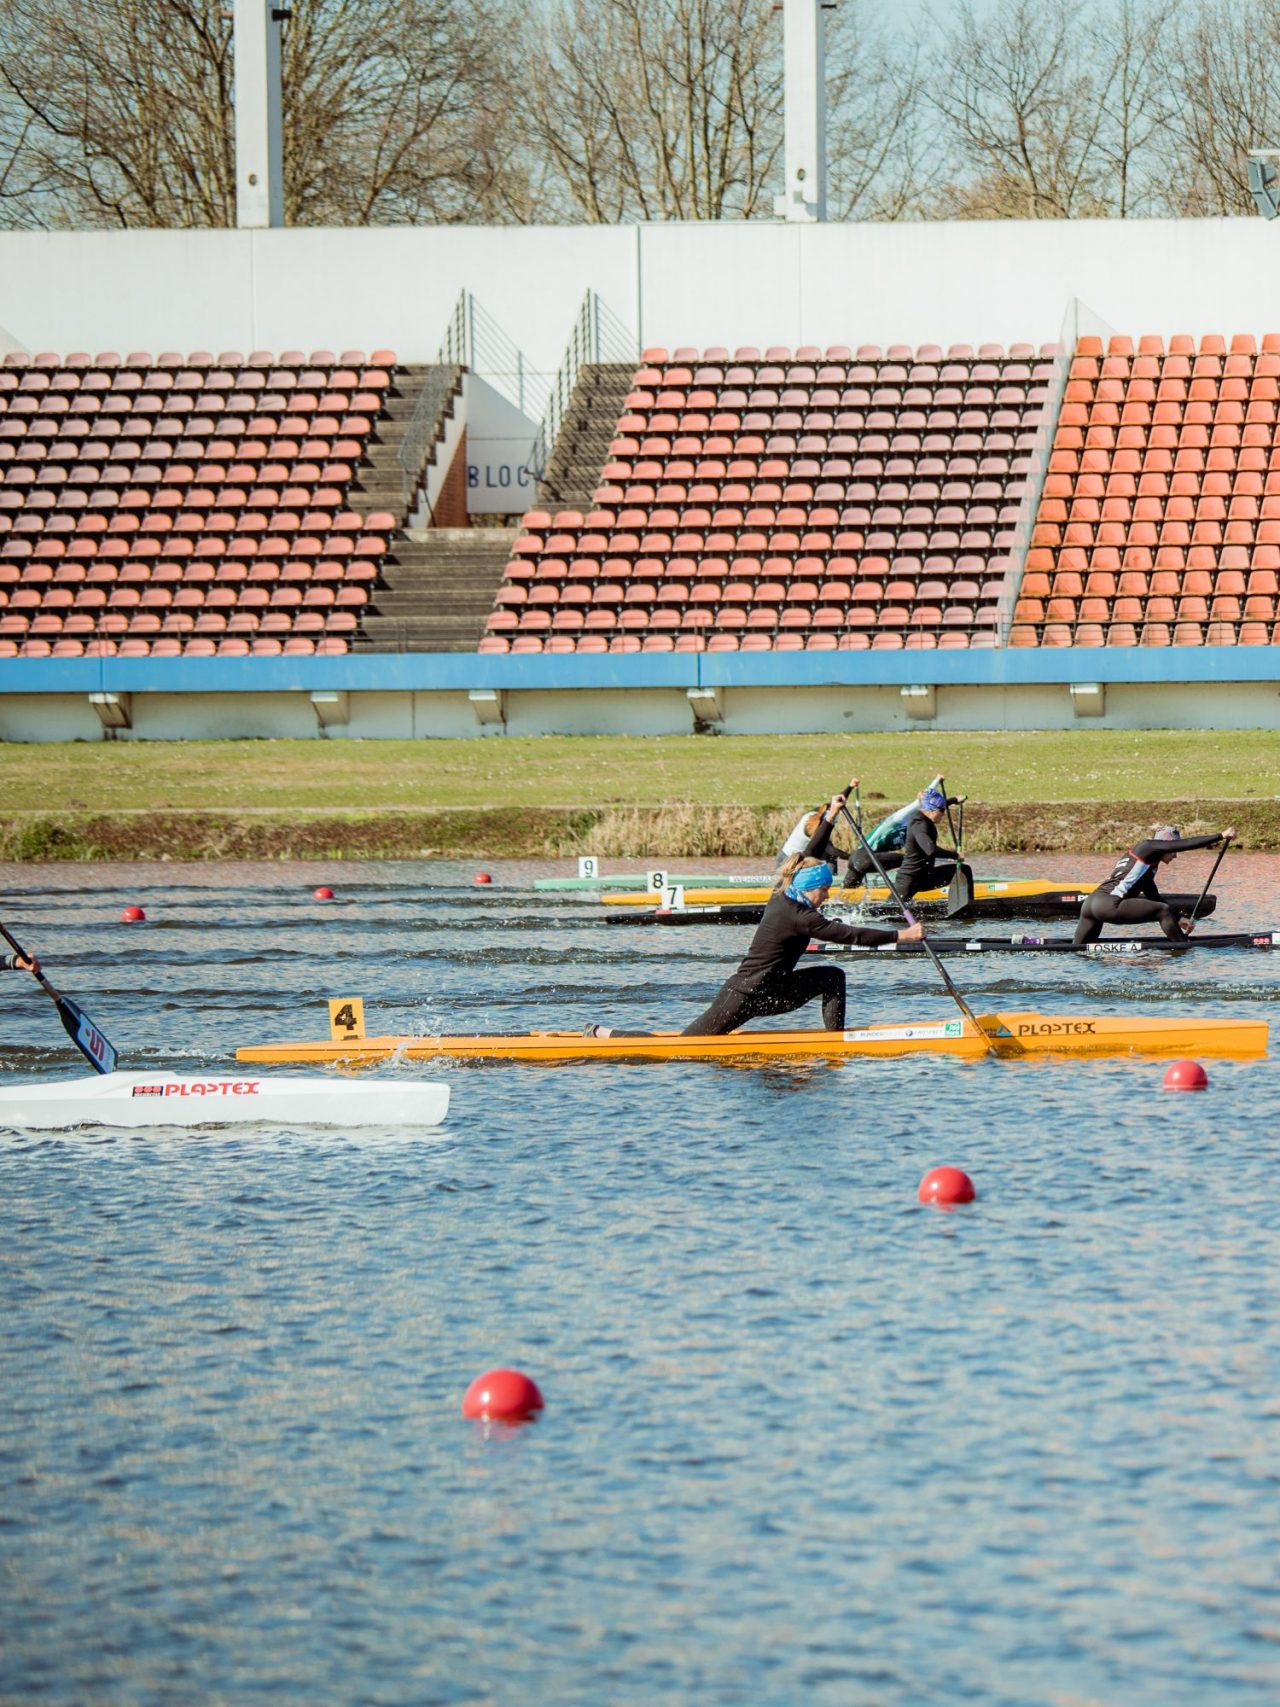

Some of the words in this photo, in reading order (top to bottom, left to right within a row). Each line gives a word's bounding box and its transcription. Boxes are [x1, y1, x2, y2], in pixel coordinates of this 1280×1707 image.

[585, 860, 594, 874] 9
[653, 872, 664, 889] 8
[668, 887, 677, 905] 7
[334, 1004, 357, 1031] 4
[165, 1081, 260, 1097] PLASTEX
